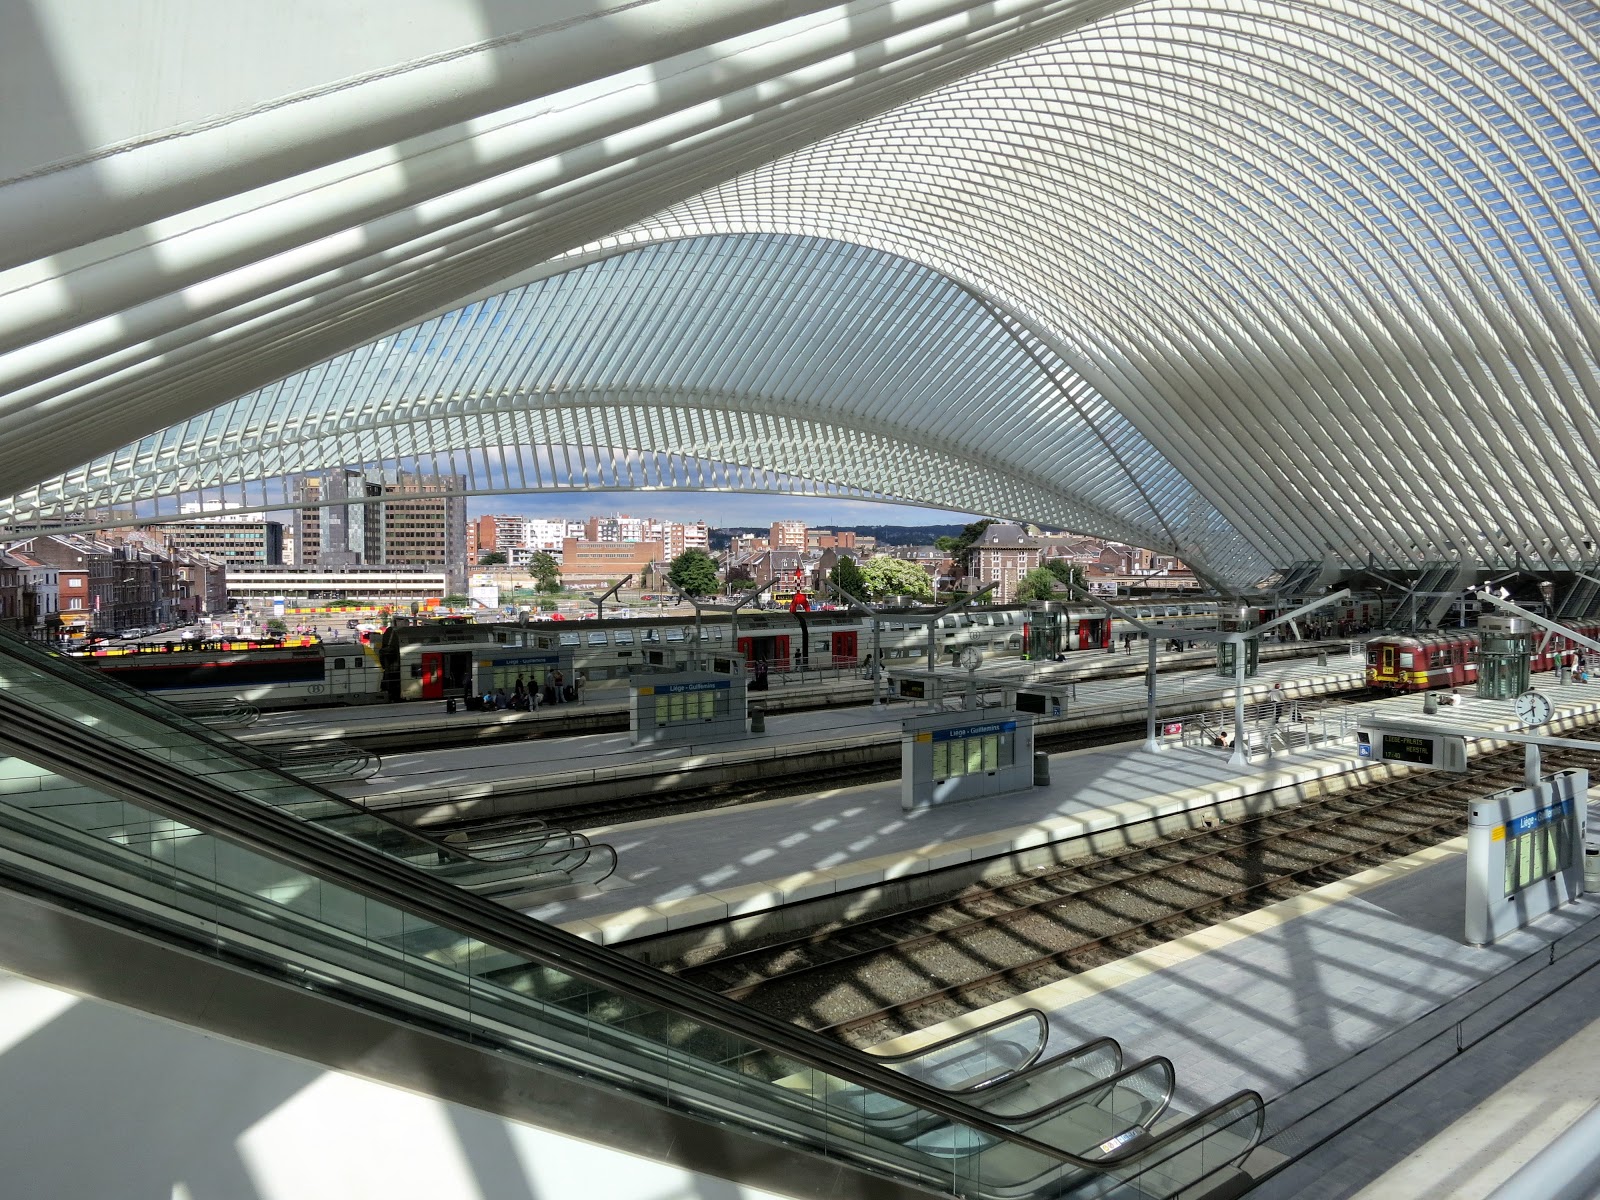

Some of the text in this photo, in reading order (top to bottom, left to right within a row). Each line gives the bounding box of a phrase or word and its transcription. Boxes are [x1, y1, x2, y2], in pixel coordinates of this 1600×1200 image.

[970, 725, 1000, 734] Guillemins
[1406, 746, 1429, 754] HERSTAL
[1520, 816, 1534, 828] Liège
